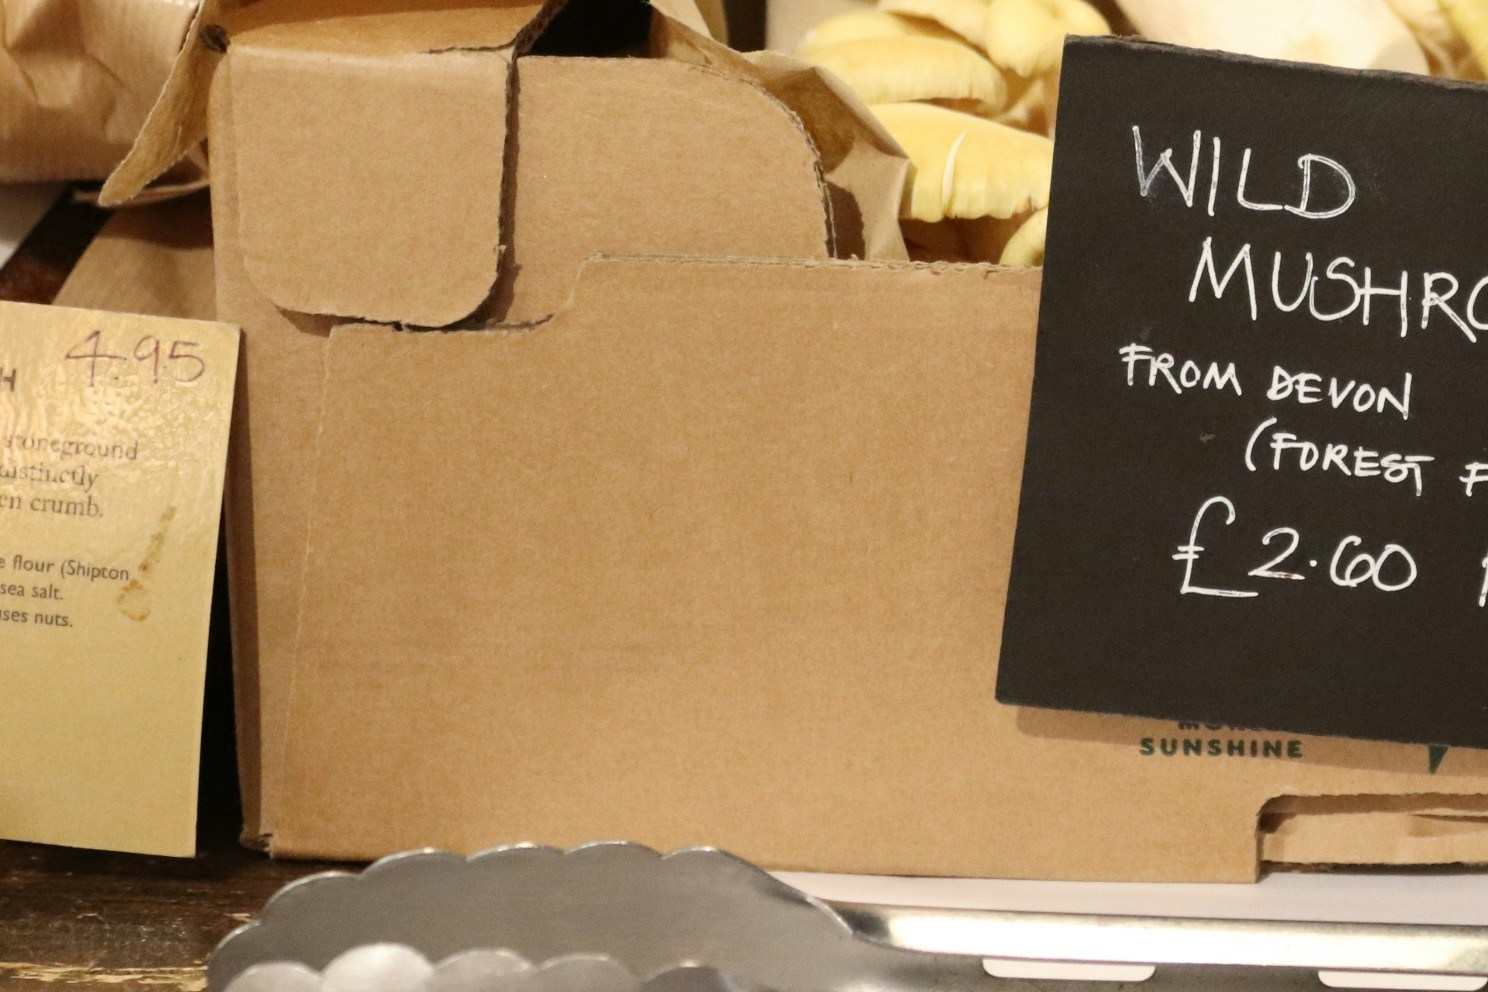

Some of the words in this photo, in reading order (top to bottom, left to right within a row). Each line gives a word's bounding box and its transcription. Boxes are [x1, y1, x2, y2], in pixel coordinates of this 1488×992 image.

[1131, 124, 1357, 220] WILD
[1118, 342, 1243, 397] FROM
[1265, 365, 1413, 421] DEVON
[1244, 416, 1436, 498] (FOREST
[29, 494, 104, 518] crumb.
[12, 554, 55, 574] flour
[60, 559, 130, 582] (Shipton
[31, 583, 64, 601] salt.
[34, 612, 73, 628] nuts.
[1138, 737, 1304, 759] SUNSHINE
